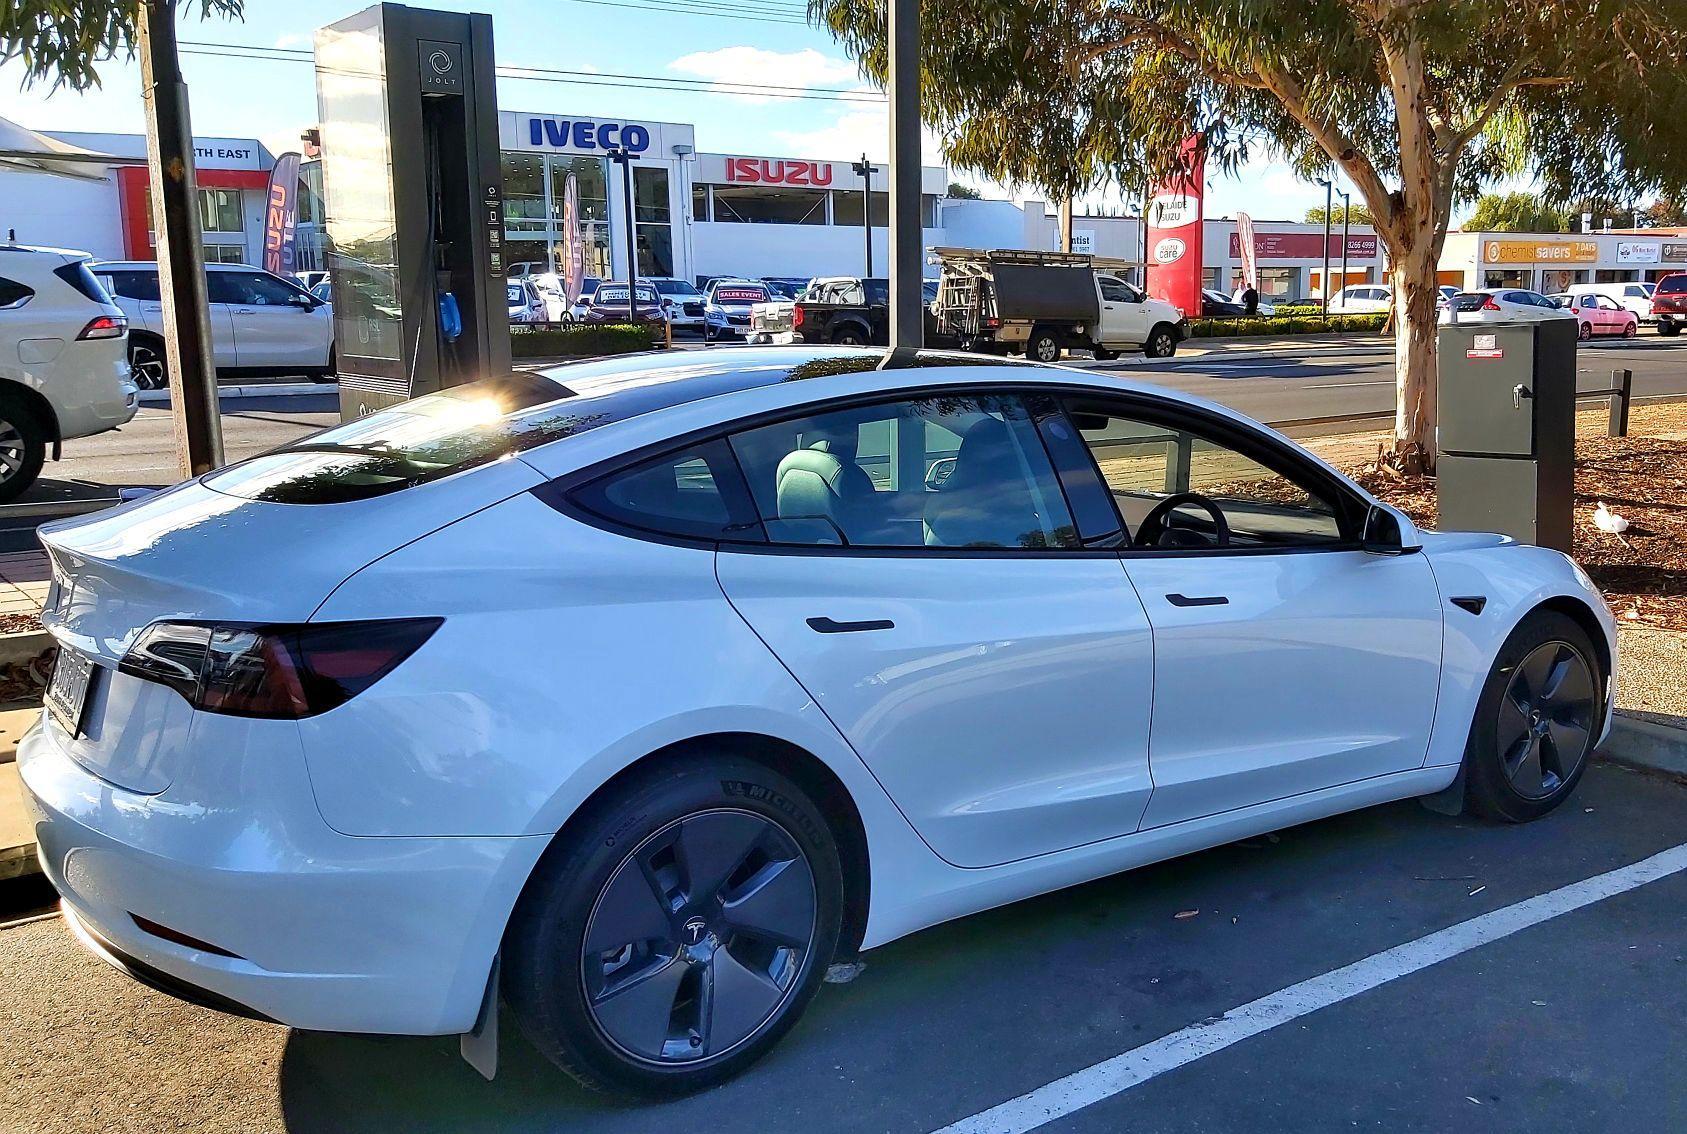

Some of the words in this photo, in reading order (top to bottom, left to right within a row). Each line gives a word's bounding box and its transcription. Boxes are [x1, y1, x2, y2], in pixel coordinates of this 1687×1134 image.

[428, 77, 456, 85] JOLT
[529, 118, 650, 152] IVECO
[217, 149, 251, 160] EAST
[726, 157, 833, 186] ISUZU
[1347, 241, 1361, 249] 8266
[1361, 241, 1375, 249] 4999
[1160, 250, 1178, 258] care
